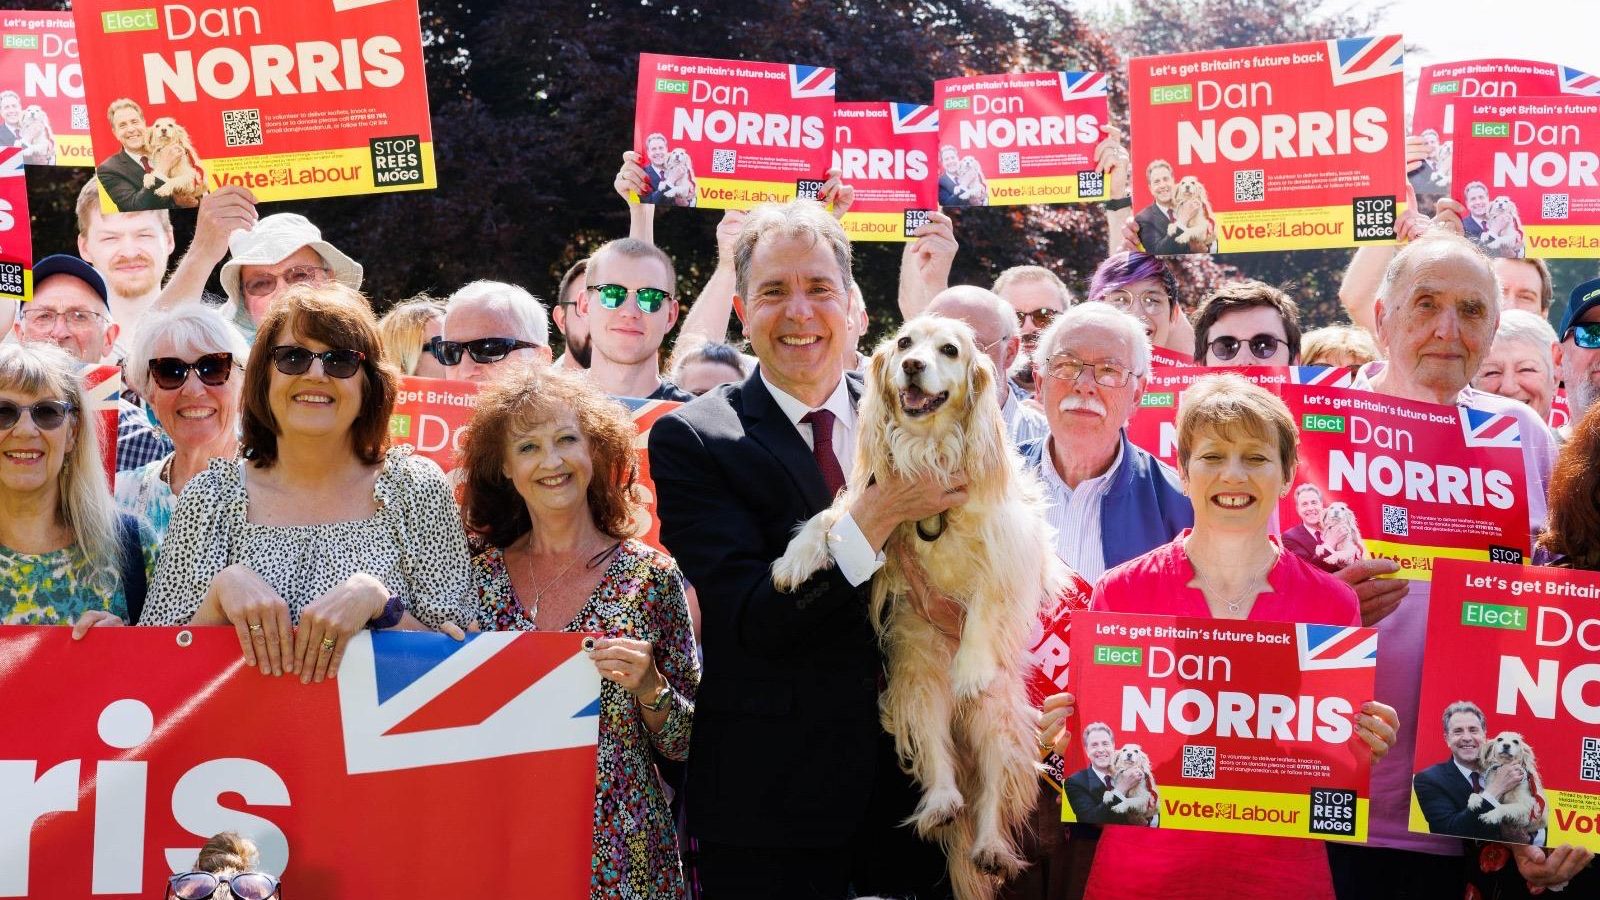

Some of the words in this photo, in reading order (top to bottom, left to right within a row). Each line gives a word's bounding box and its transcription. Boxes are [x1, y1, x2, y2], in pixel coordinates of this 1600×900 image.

[4, 18, 26, 28] Let's
[28, 18, 45, 30] get
[106, 11, 155, 30] Elect
[164, 3, 261, 41] Dan
[6, 36, 36, 47] Elect
[143, 35, 405, 105] NORRIS
[656, 63, 679, 72] Let's
[680, 64, 697, 75] get
[698, 65, 735, 76] Britain's
[736, 68, 763, 78] future
[764, 70, 786, 80] back
[1150, 65, 1177, 77] Let's
[1179, 62, 1199, 77] get
[1201, 58, 1251, 72] Britain's
[1252, 56, 1291, 68] future
[1292, 51, 1325, 64] back
[1432, 68, 1451, 77] Let's
[1452, 67, 1466, 77] get
[1466, 64, 1504, 73] Britain's
[1504, 64, 1532, 74] future
[1533, 66, 1555, 77] back
[657, 79, 686, 92] Elect
[691, 79, 749, 106] Dan
[945, 85, 961, 93] Let's
[962, 83, 975, 93] get
[976, 80, 1009, 90] Britain's
[1009, 79, 1035, 88] future
[1036, 78, 1057, 87] back
[1432, 82, 1457, 94] Elect
[1462, 77, 1517, 98] Dan
[1153, 86, 1189, 102] Elect
[1197, 80, 1273, 111] Dan
[945, 98, 968, 109] Elect
[973, 94, 1024, 115] Dan
[1473, 105, 1497, 114] Let's
[1499, 105, 1517, 116] get
[1518, 104, 1563, 115] Britain's
[1564, 104, 1598, 114] future
[838, 109, 865, 118] future
[866, 109, 888, 118] back
[672, 107, 825, 149] NORRIS
[960, 114, 1100, 150] NORRIS
[1177, 106, 1389, 166] NORRIS
[1475, 123, 1506, 135] Elect
[1513, 120, 1580, 146] Dan
[374, 139, 416, 155] STOP
[376, 154, 419, 169] REES
[1493, 151, 1600, 188] NOR
[289, 164, 362, 185] Labour
[1079, 171, 1102, 181] STOP
[991, 186, 1021, 198] Vote
[1032, 185, 1072, 196] Labour
[1079, 180, 1103, 188] REES
[700, 187, 733, 200] Vote
[745, 187, 790, 203] Labour
[798, 190, 819, 200] REE
[1356, 199, 1393, 213] STOP
[855, 221, 898, 232] Labour
[1356, 211, 1394, 226] REES
[1221, 224, 1266, 240] Vote
[1282, 220, 1345, 237] Labour
[1529, 235, 1570, 249] Vote
[1163, 376, 1181, 387] get
[1260, 374, 1286, 384] back
[396, 390, 424, 405] get
[1140, 394, 1172, 405] Elect
[1303, 394, 1331, 405] Let's
[1332, 397, 1352, 409] get
[1353, 398, 1396, 415] Britain's
[1397, 406, 1428, 420] future
[1429, 412, 1457, 425] back
[1305, 415, 1342, 430] Elect
[1350, 415, 1413, 453] Dan
[1328, 450, 1515, 510] NORRIS
[1492, 548, 1521, 562] STOP
[1465, 574, 1507, 590] Let's
[1510, 579, 1541, 596] get
[1466, 604, 1522, 627] Elect
[1096, 623, 1127, 636] Let's
[1129, 626, 1151, 640] get
[1154, 626, 1210, 640] Britain's
[1212, 629, 1254, 643] future
[1256, 631, 1291, 645] back
[1098, 647, 1138, 663] Elect
[1148, 646, 1232, 682] Dan
[1121, 685, 1354, 744] NORRIS
[1314, 791, 1354, 806] STOP
[1164, 799, 1214, 818] Vote
[1232, 802, 1300, 824] Labour
[1313, 804, 1353, 819] REES
